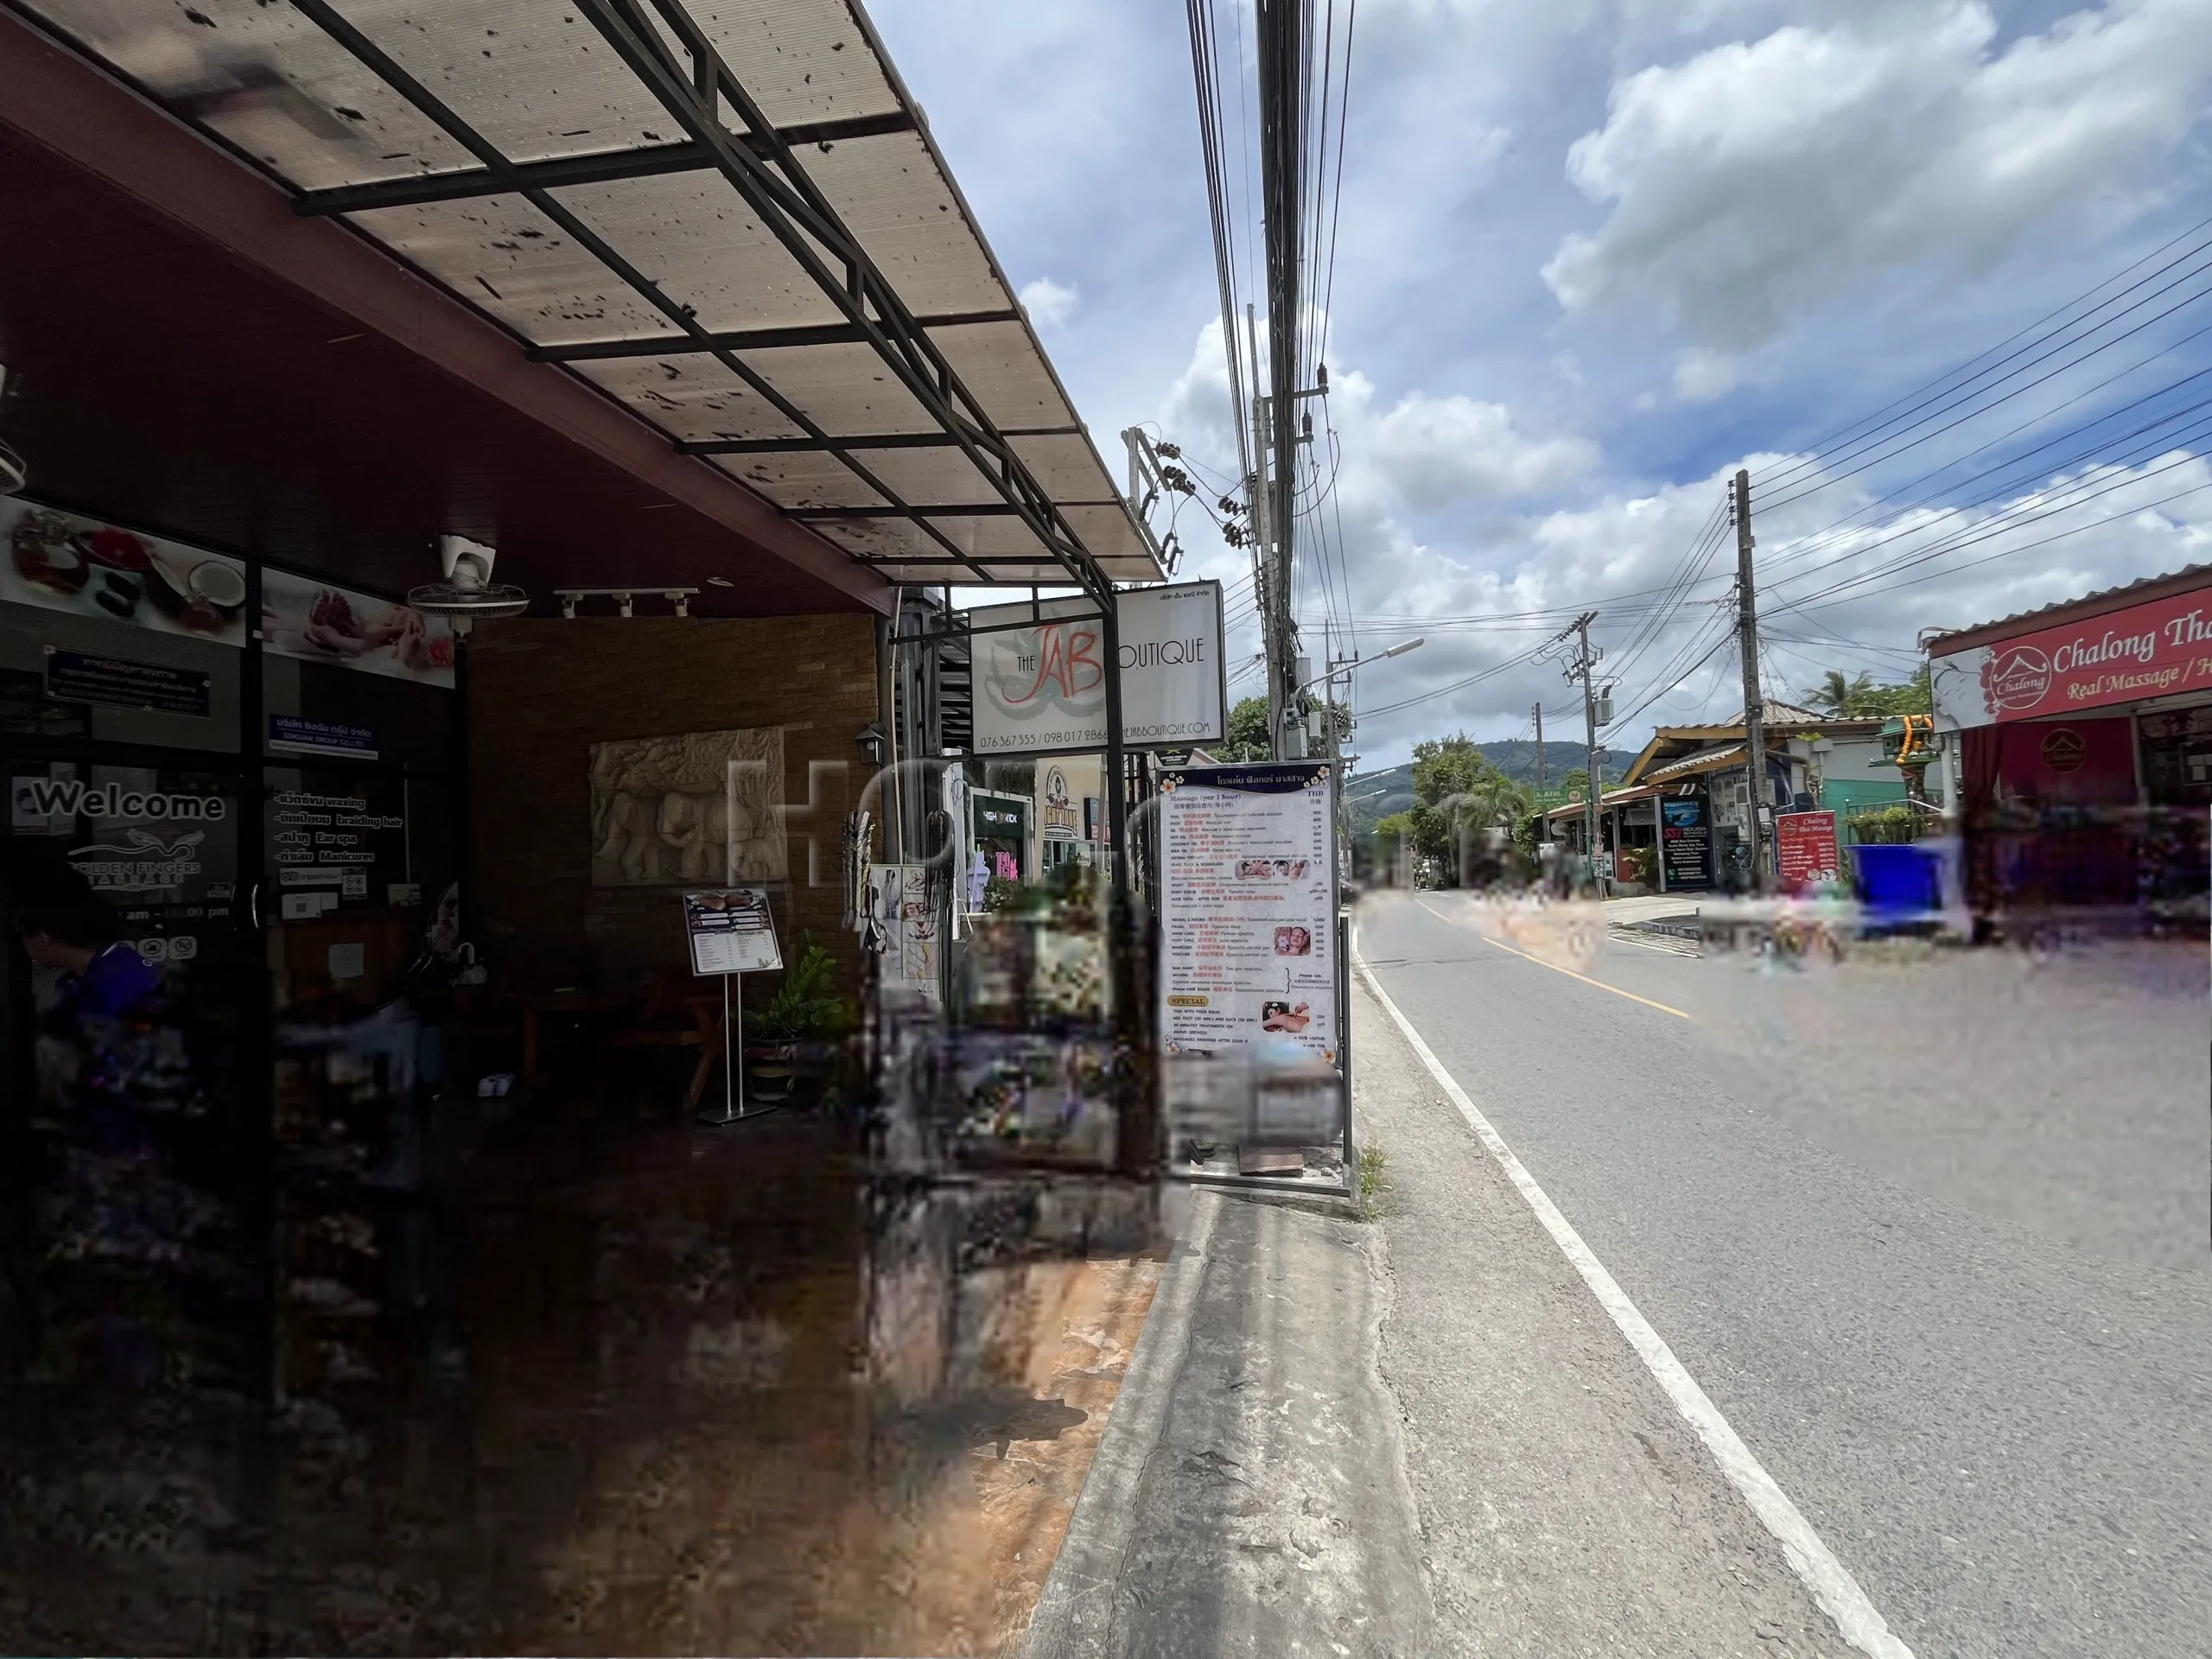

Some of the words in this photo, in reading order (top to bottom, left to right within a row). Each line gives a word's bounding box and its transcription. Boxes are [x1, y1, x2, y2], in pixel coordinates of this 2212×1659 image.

[2054, 631, 2155, 673] Chalong
[1002, 623, 1104, 703] JAB
[1018, 655, 1035, 672] THE
[1997, 677, 2045, 696] Chalong
[2068, 675, 2102, 700] Real
[2106, 666, 2180, 693] Massage
[980, 736, 997, 747] 076
[1045, 733, 1062, 743] 098
[30, 779, 226, 821] Welcome
[326, 798, 366, 810] waxing
[336, 814, 381, 830] braiding
[383, 816, 404, 828] hair
[315, 832, 336, 844] Ear
[337, 834, 358, 846] spa
[319, 850, 376, 862] Manicures
[137, 862, 200, 874] FINGERS
[126, 910, 149, 919] am
[207, 907, 230, 919] pm
